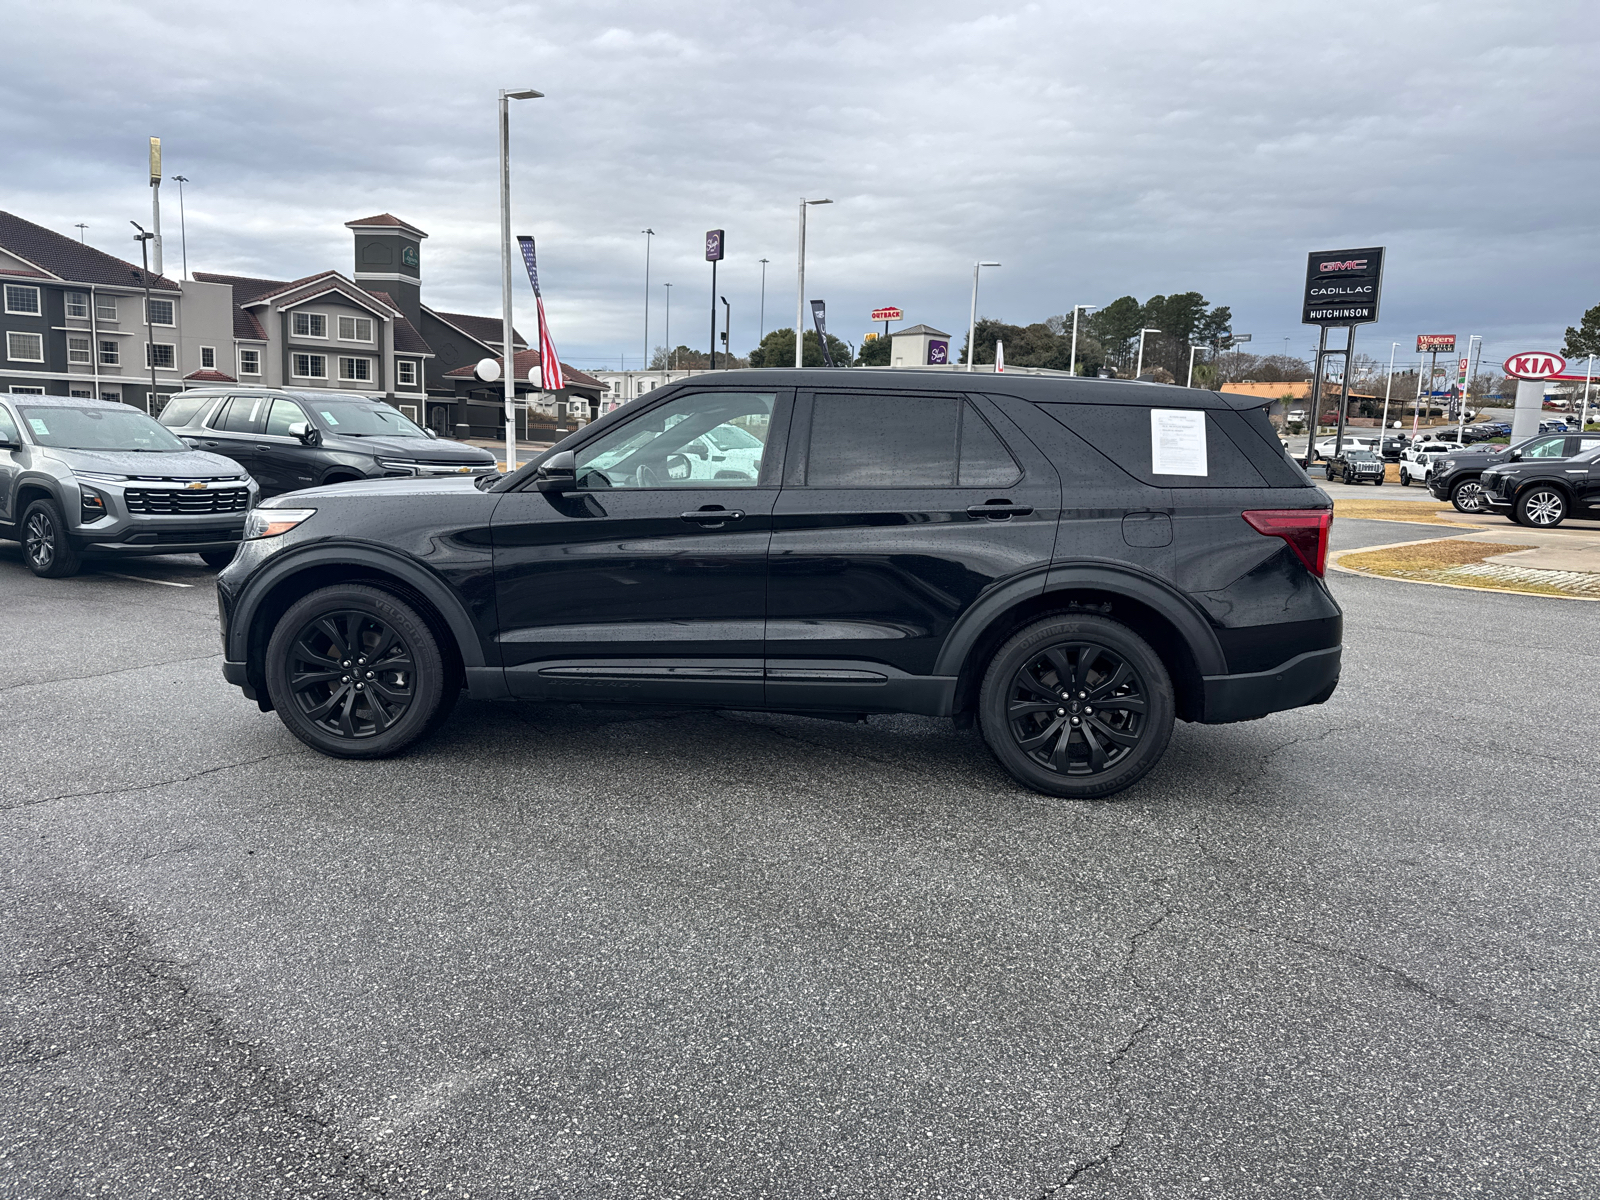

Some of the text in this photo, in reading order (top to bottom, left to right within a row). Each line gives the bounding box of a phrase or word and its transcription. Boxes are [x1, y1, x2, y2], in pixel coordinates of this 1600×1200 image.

[1320, 260, 1368, 272] GMC
[1310, 285, 1372, 295] CADILLAC
[871, 311, 900, 319] OUTBACK
[1310, 308, 1369, 319] HUTCHINSON
[1419, 335, 1454, 345] Wagers
[1515, 357, 1555, 374] KIA
[375, 600, 425, 648] VELOCITY
[1020, 623, 1080, 649] OMNIMAX
[1085, 759, 1148, 794] VELOCITY
